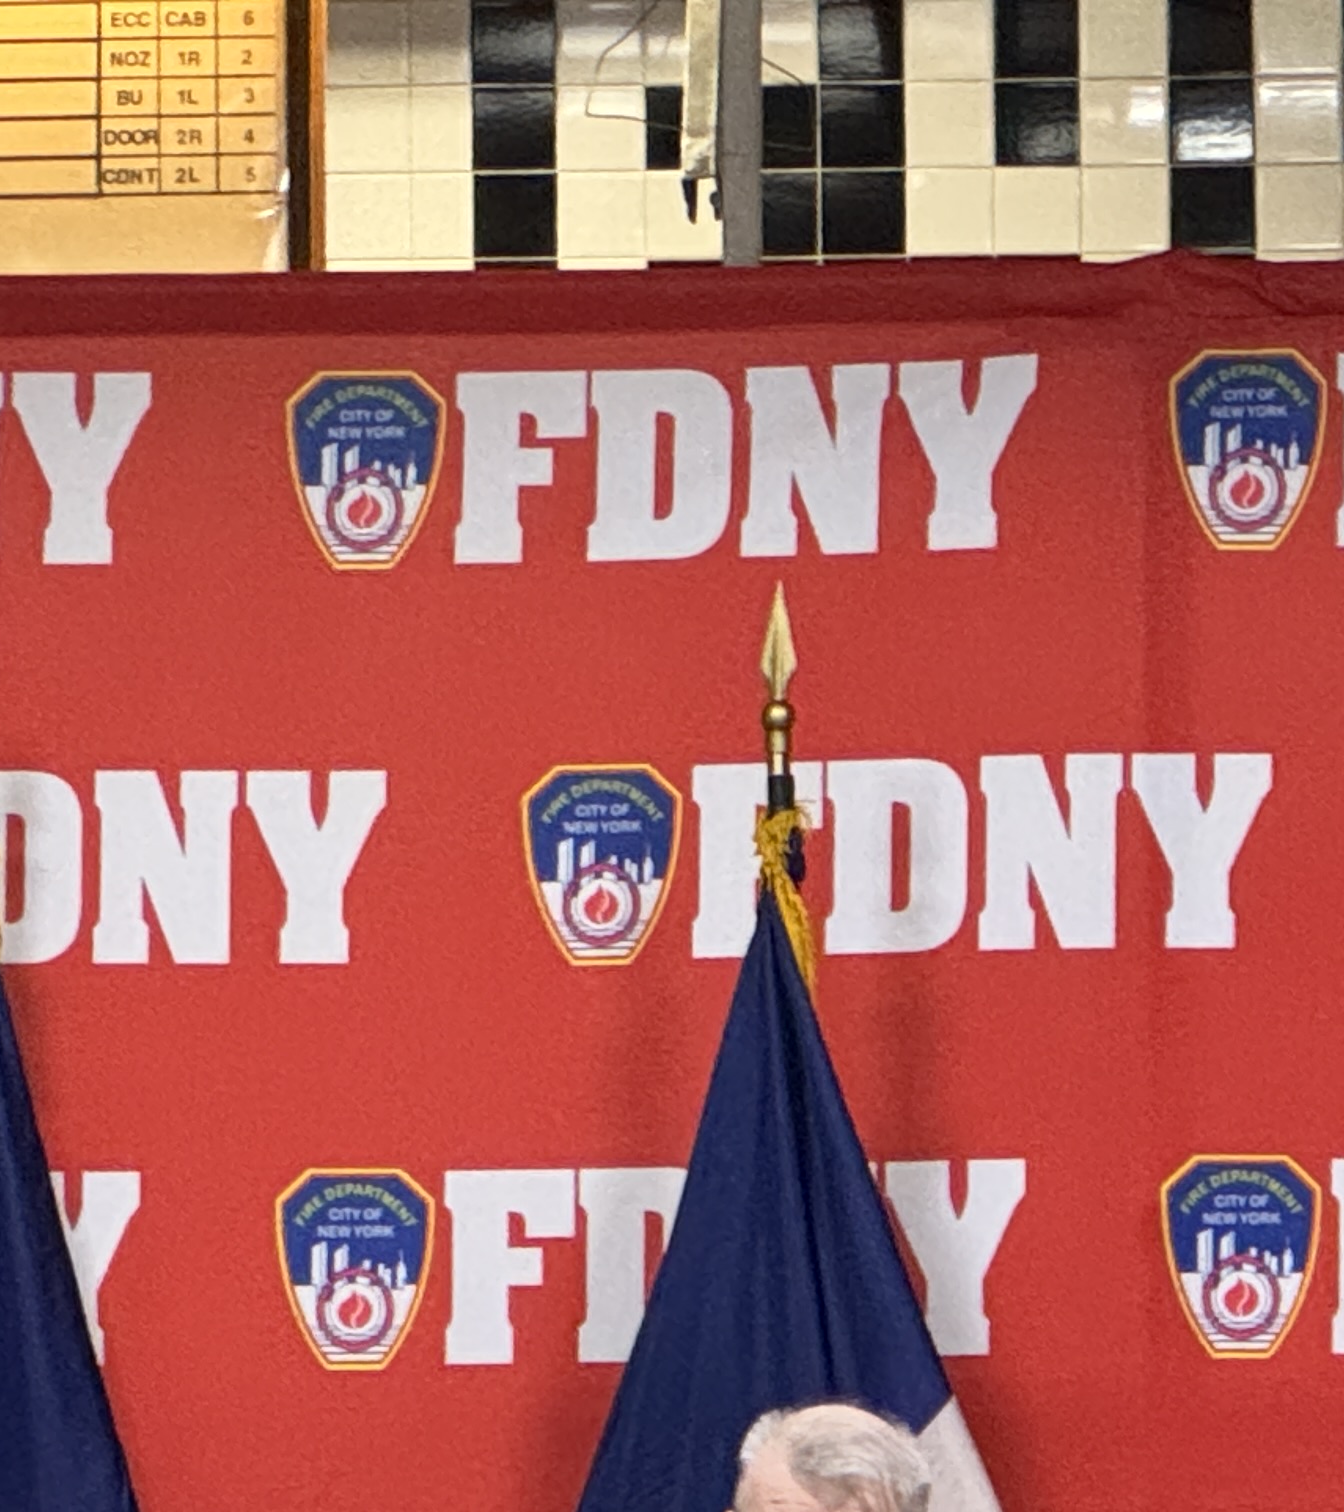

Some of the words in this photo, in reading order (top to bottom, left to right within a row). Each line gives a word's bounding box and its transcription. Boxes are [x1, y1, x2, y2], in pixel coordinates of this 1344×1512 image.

[110, 13, 151, 27] ECC
[165, 11, 207, 27] CAB
[243, 11, 255, 26] 6
[109, 51, 151, 67] NOZ
[178, 51, 201, 66] 1R
[241, 49, 253, 65] 2
[116, 89, 144, 106] BU
[178, 89, 199, 105] 1L
[103, 129, 158, 145] DOOR
[175, 129, 203, 144] 2R
[243, 128, 255, 144] 4
[102, 168, 157, 185] CONT
[174, 168, 200, 184] 2L
[1221, 388, 1255, 401] CITY
[1257, 388, 1278, 401] OF
[339, 409, 371, 423] CITY
[374, 409, 395, 423] OF
[1209, 405, 1244, 418] NEW
[1247, 405, 1288, 418] YORK
[327, 426, 362, 439] NEW
[366, 426, 406, 439] YORK
[455, 354, 1037, 563] FDNY
[574, 803, 607, 817] CITY
[610, 803, 631, 817] OF
[562, 821, 598, 834] NEW
[601, 821, 642, 834] YORK
[692, 753, 1271, 958] FDNY
[1213, 1194, 1247, 1208] CITY
[1249, 1194, 1270, 1208] OF
[328, 1207, 361, 1221] CITY
[363, 1207, 384, 1221] OF
[1201, 1212, 1238, 1225] NEW
[1240, 1212, 1282, 1225] YORK
[316, 1225, 352, 1238] NEW
[354, 1225, 395, 1238] YORK
[444, 1158, 1025, 1364] FDY
